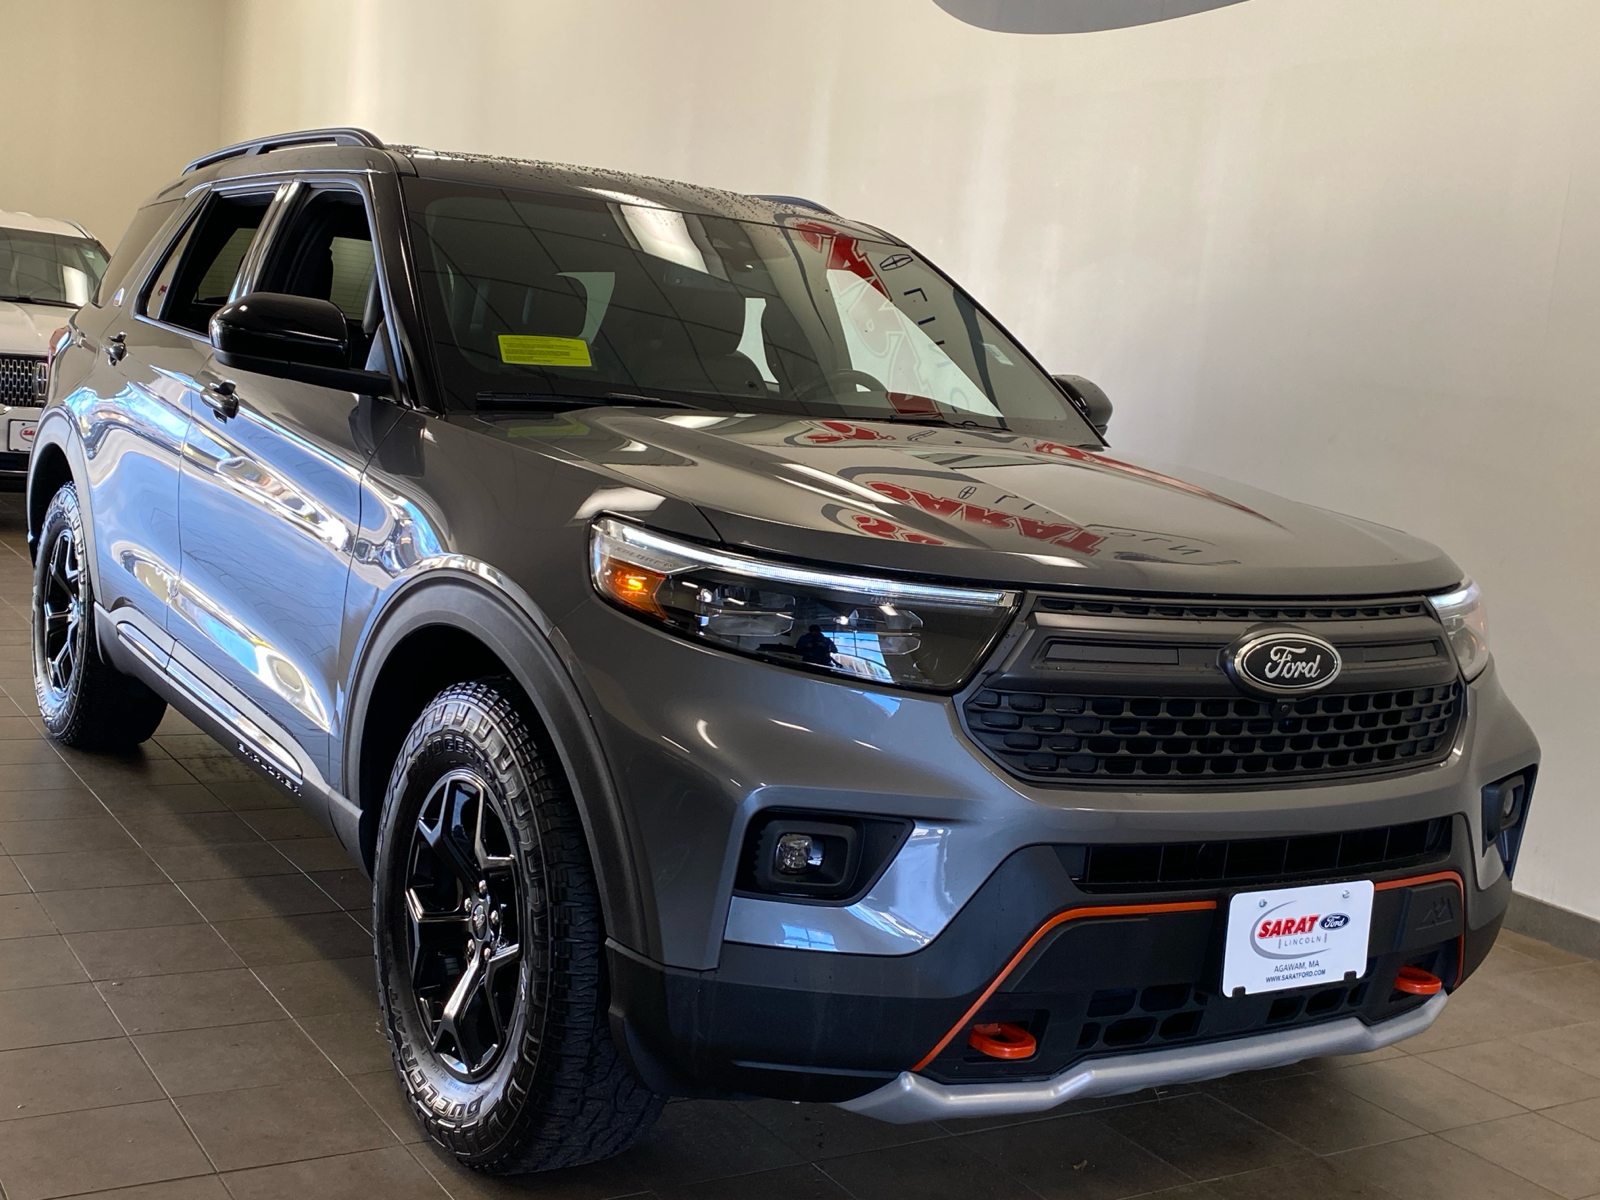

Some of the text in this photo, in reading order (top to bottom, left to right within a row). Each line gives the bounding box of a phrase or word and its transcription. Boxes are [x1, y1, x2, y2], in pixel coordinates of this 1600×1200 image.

[1264, 645, 1321, 679] Ford
[1258, 914, 1346, 938] SARAT Ford
[1284, 936, 1322, 947] LINCOLN
[1308, 960, 1320, 968] MA
[1266, 969, 1326, 982] WWW.SARATFORD.COM
